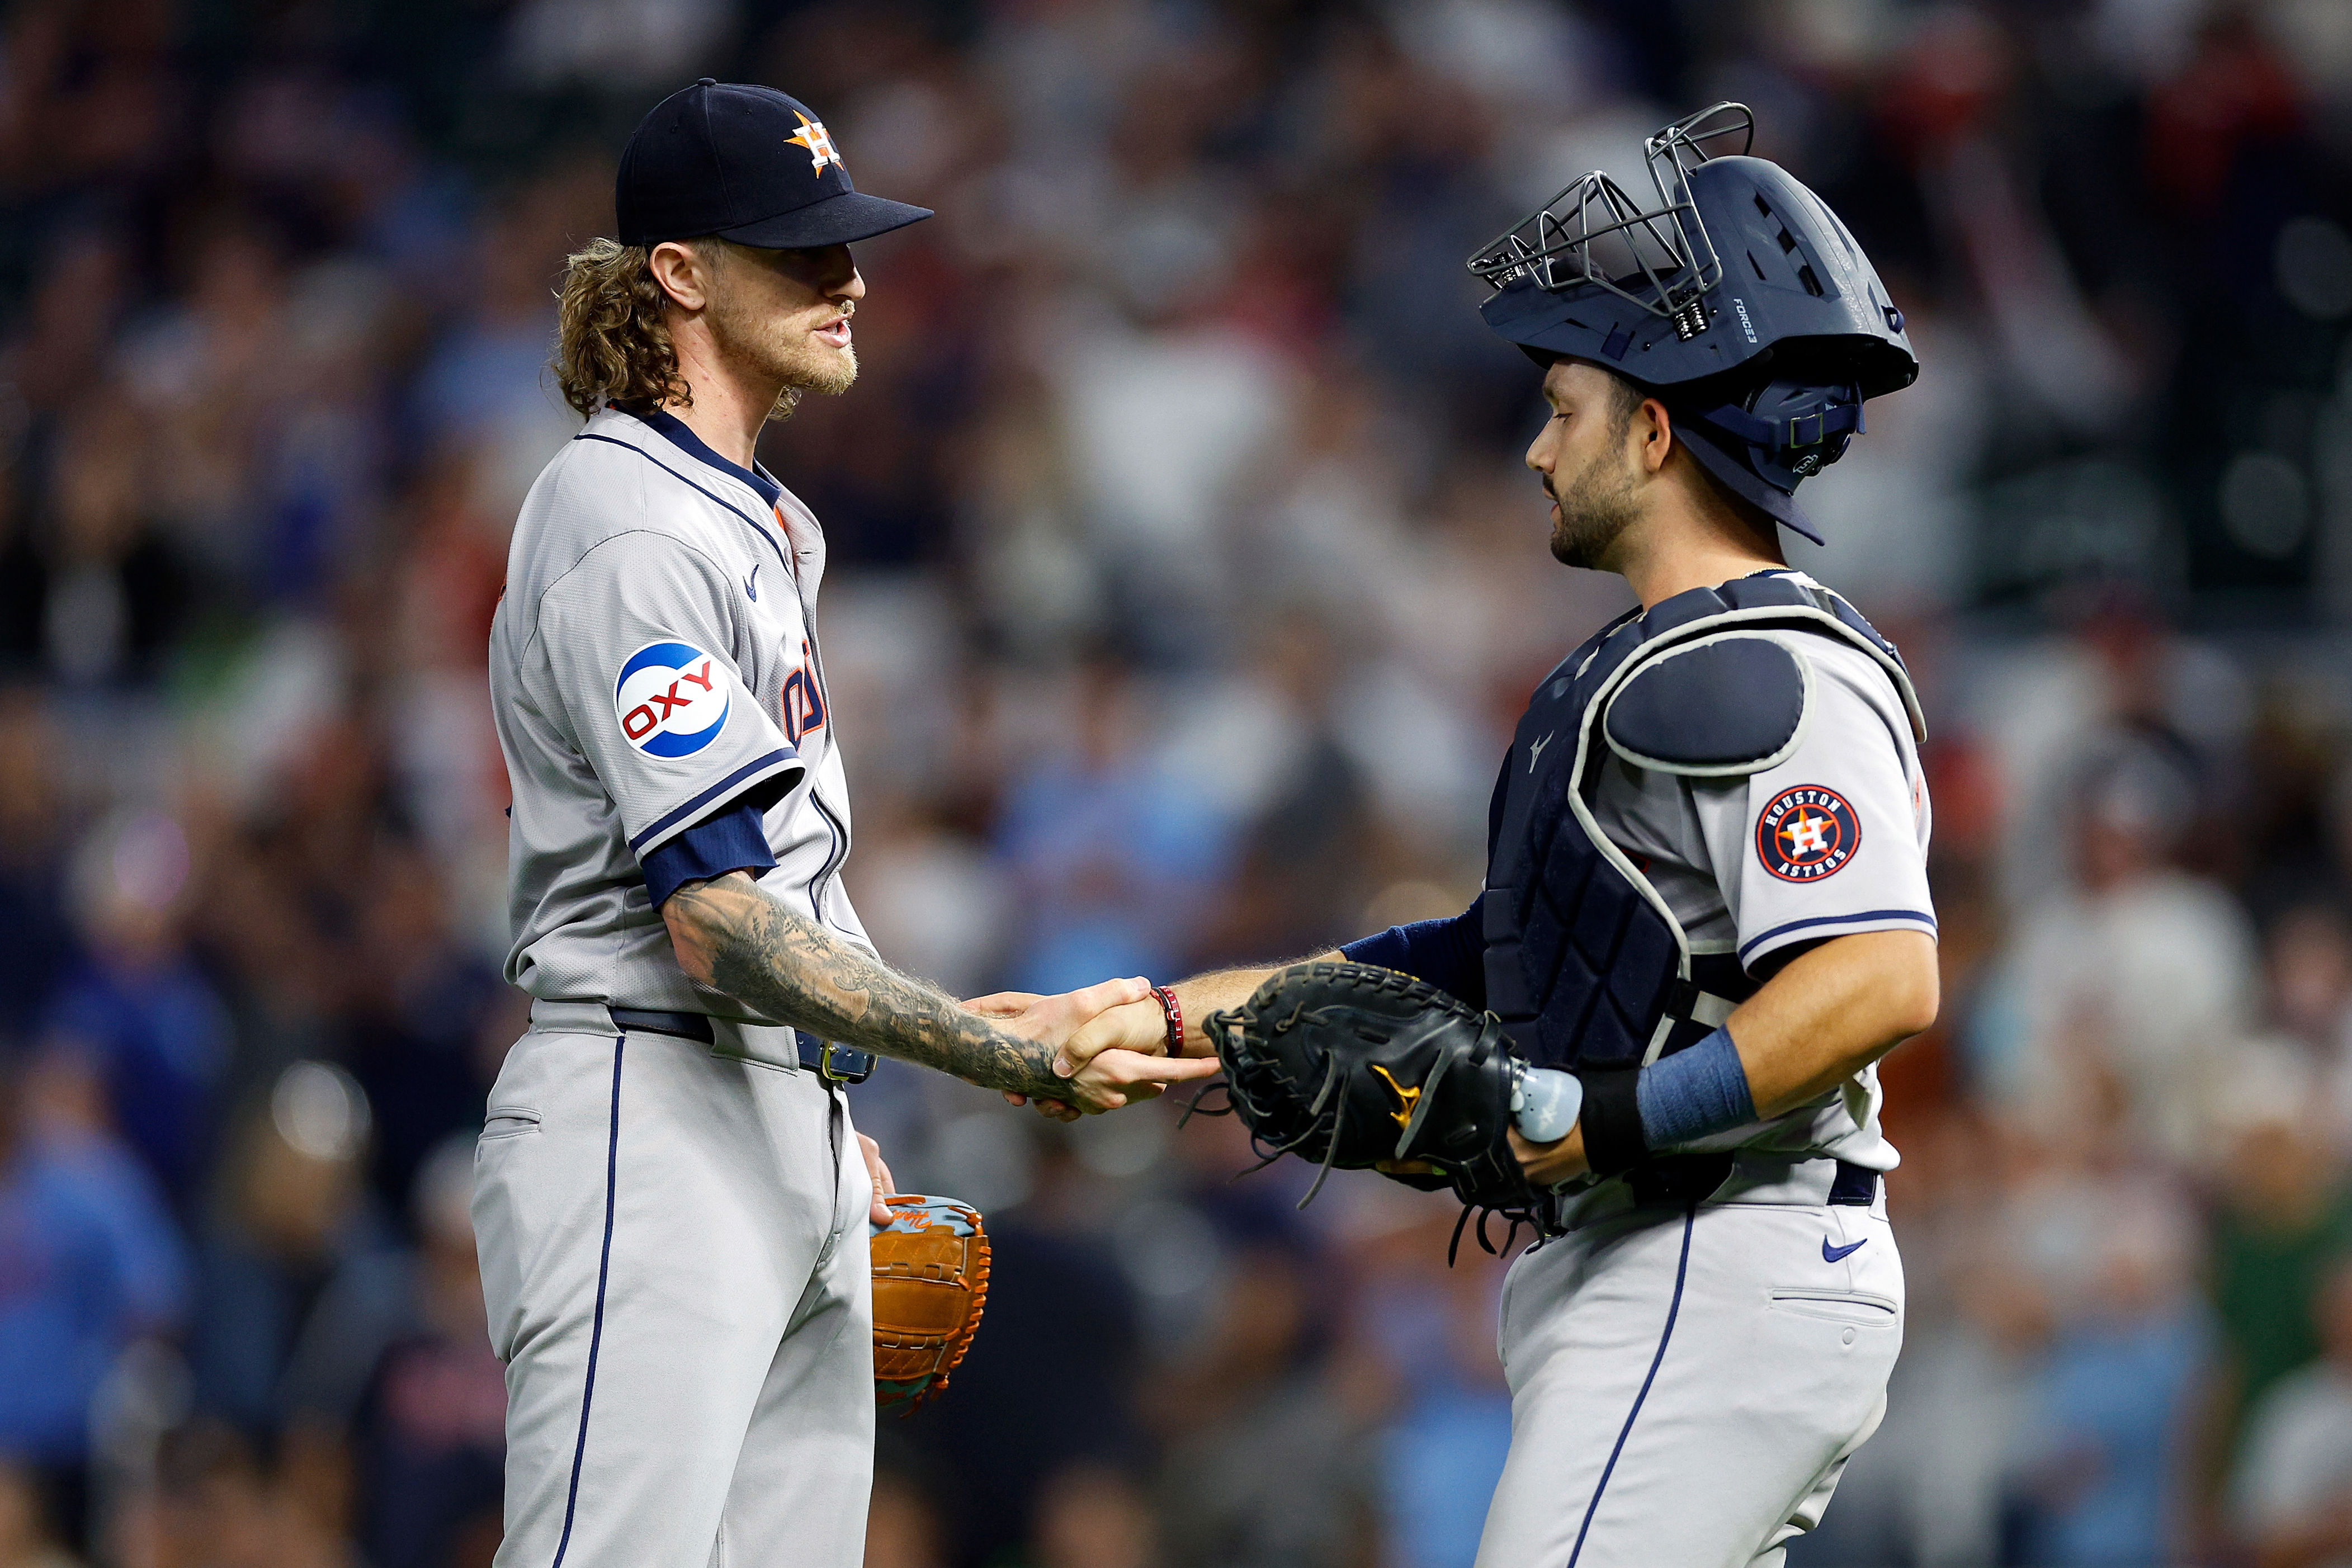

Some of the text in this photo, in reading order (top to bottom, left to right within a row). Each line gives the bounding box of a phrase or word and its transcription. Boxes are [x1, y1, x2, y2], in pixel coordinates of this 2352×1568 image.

[1733, 298, 1758, 343] FORCE3
[622, 660, 714, 740] OXY
[1765, 791, 1841, 826] HOUSTON
[1778, 849, 1846, 877] ASTROS
